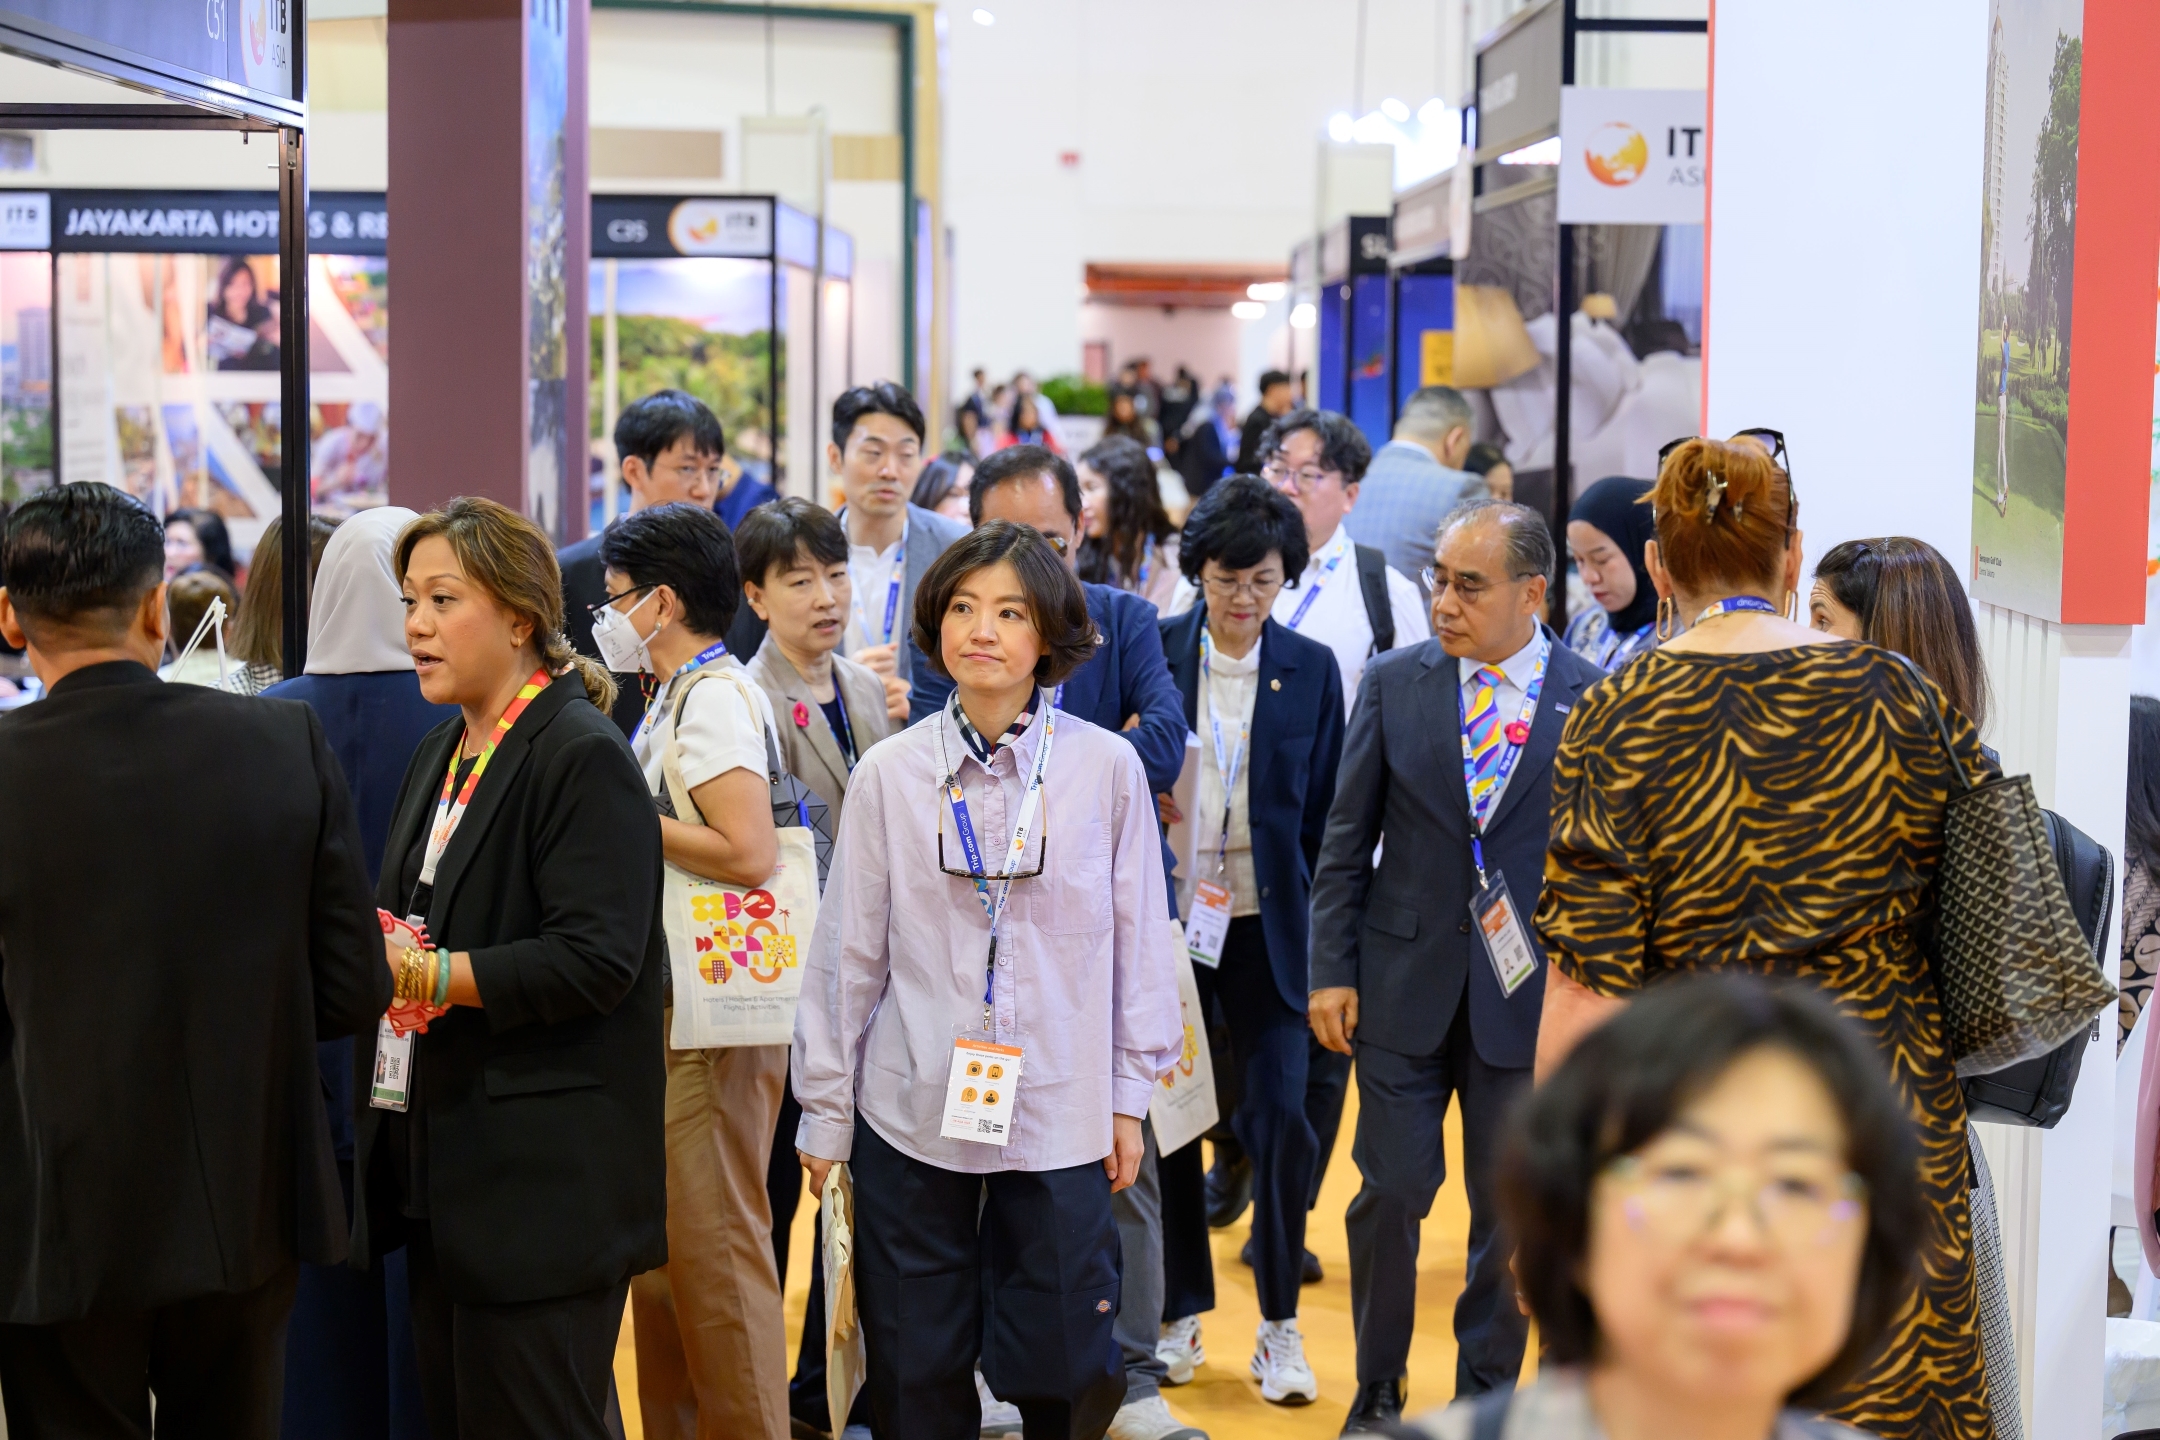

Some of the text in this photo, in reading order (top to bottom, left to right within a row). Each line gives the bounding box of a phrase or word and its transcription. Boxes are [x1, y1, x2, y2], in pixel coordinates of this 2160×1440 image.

[271, 43, 287, 70] ASIA
[65, 208, 219, 237] JAYAKARTA
[223, 210, 327, 239] HOTS
[331, 211, 354, 239] &
[701, 646, 723, 660] Trip.com
[1500, 745, 1517, 772] Trip.com
[960, 812, 980, 871] Trip.com Group
[1016, 826, 1024, 838] ITB
[998, 880, 1010, 909] Trip.com
[723, 1004, 746, 1012] Flights
